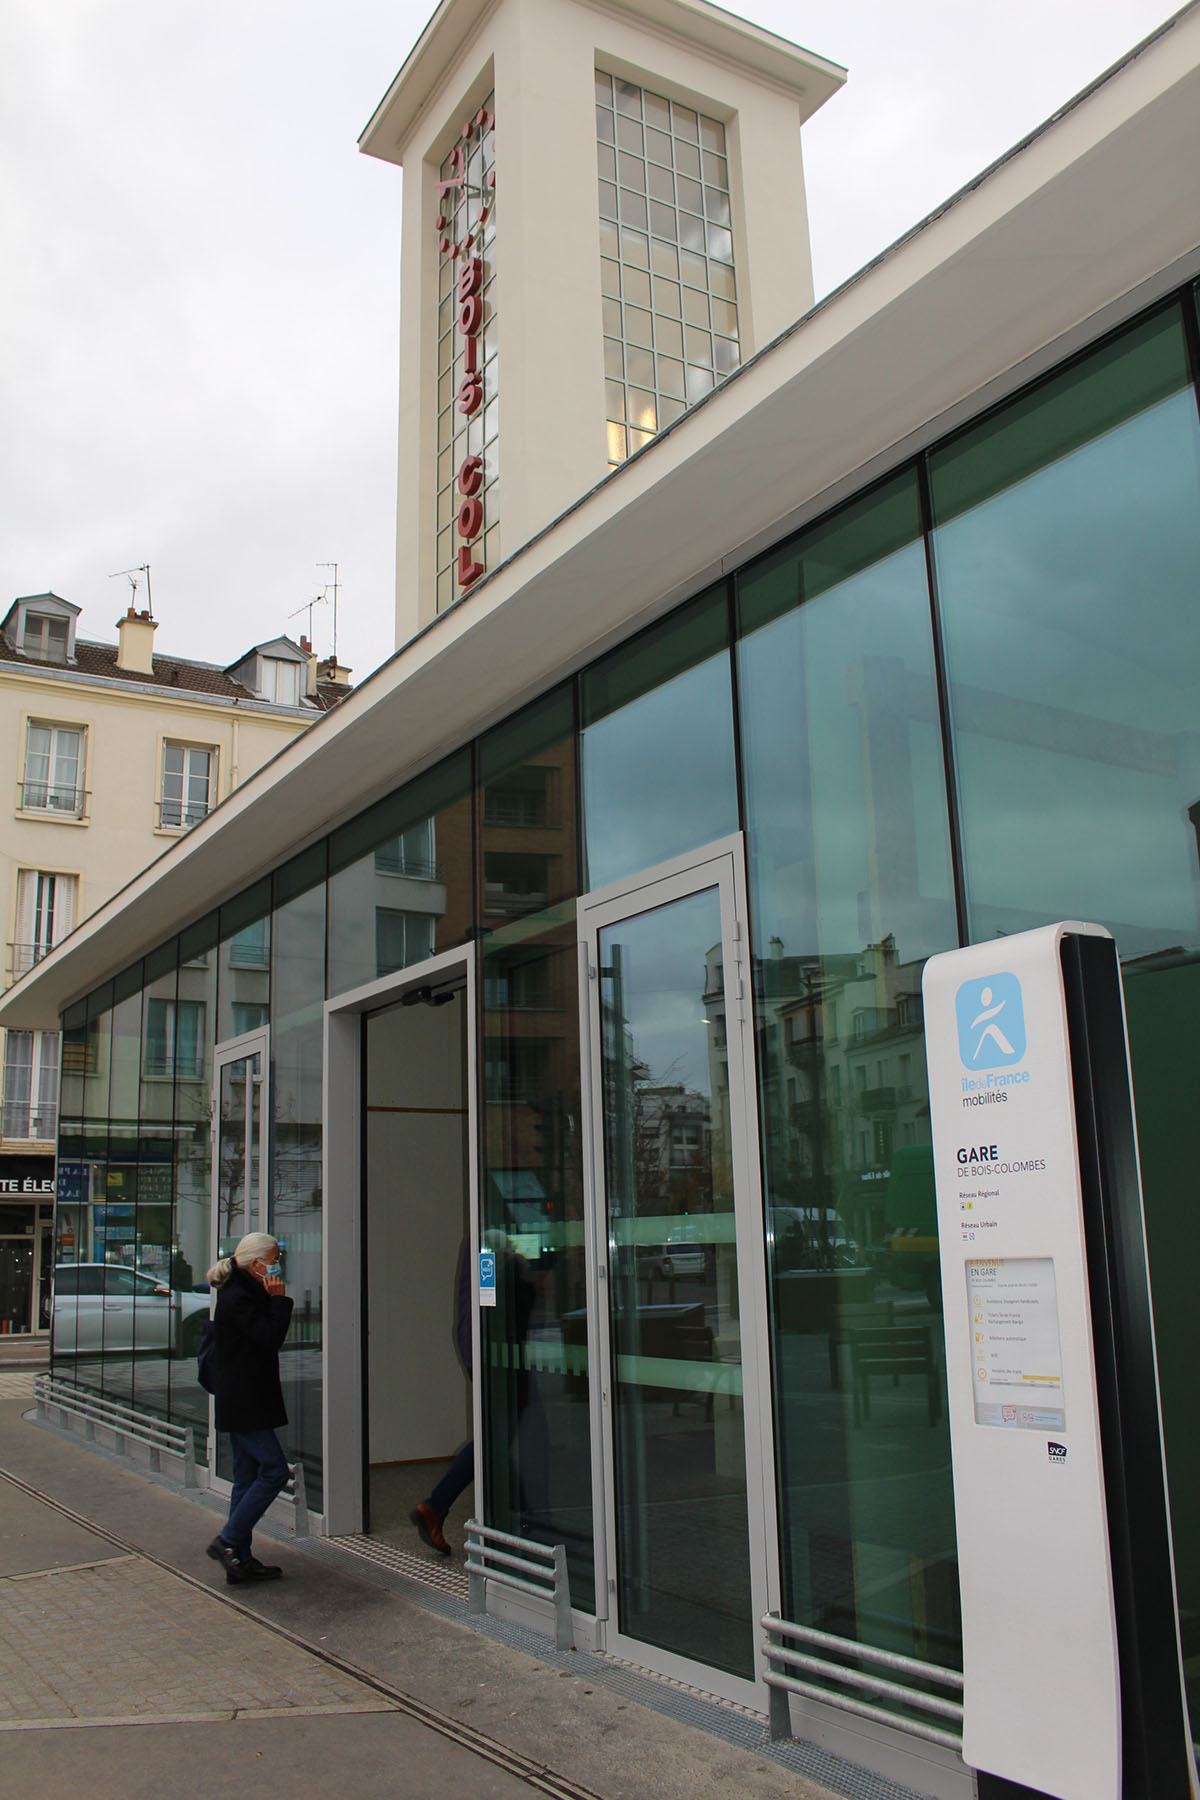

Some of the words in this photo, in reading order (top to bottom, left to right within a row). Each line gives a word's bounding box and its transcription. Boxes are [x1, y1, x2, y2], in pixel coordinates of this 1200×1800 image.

[459, 257, 483, 415] BOIS
[458, 455, 484, 596] COL
[962, 1089, 1008, 1107] mobilités
[957, 1145, 999, 1164] GARE
[957, 1167, 969, 1178] DE
[971, 1159, 1046, 1177] BOIS-COLOMBES
[977, 1189, 1000, 1199] Régional
[979, 1220, 998, 1228] Urbain
[970, 1268, 980, 1276] EN
[980, 1267, 998, 1276] GARE
[1049, 1446, 1066, 1455] SNCF
